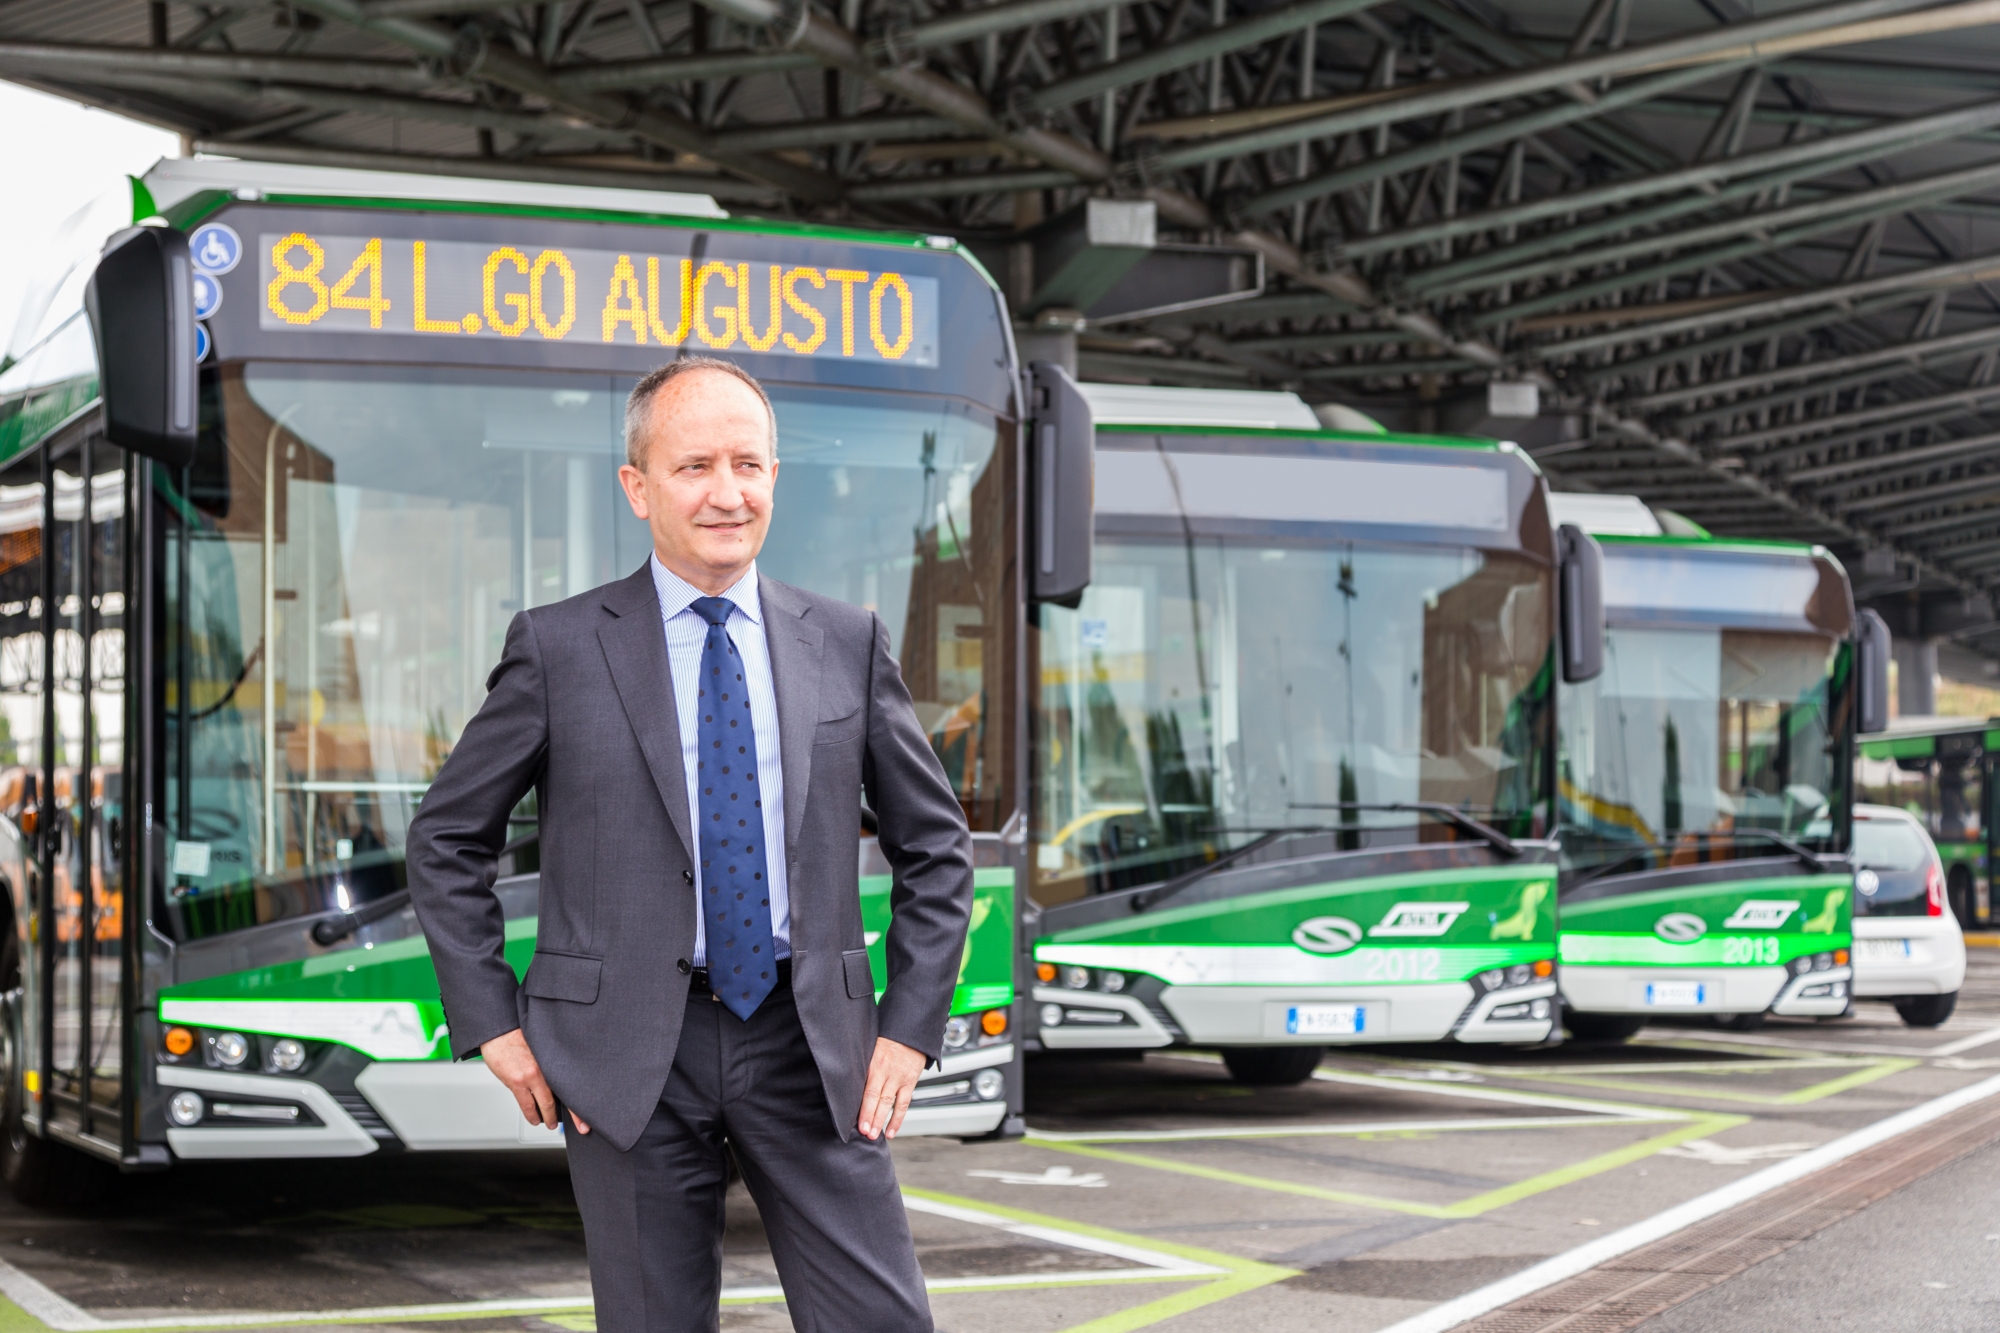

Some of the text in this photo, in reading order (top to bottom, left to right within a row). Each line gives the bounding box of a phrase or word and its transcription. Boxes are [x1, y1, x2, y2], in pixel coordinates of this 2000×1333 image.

[267, 231, 914, 358] 84 L.GO AUGUSTO
[1365, 948, 1441, 981] 2012
[1722, 936, 1780, 964] 2013
